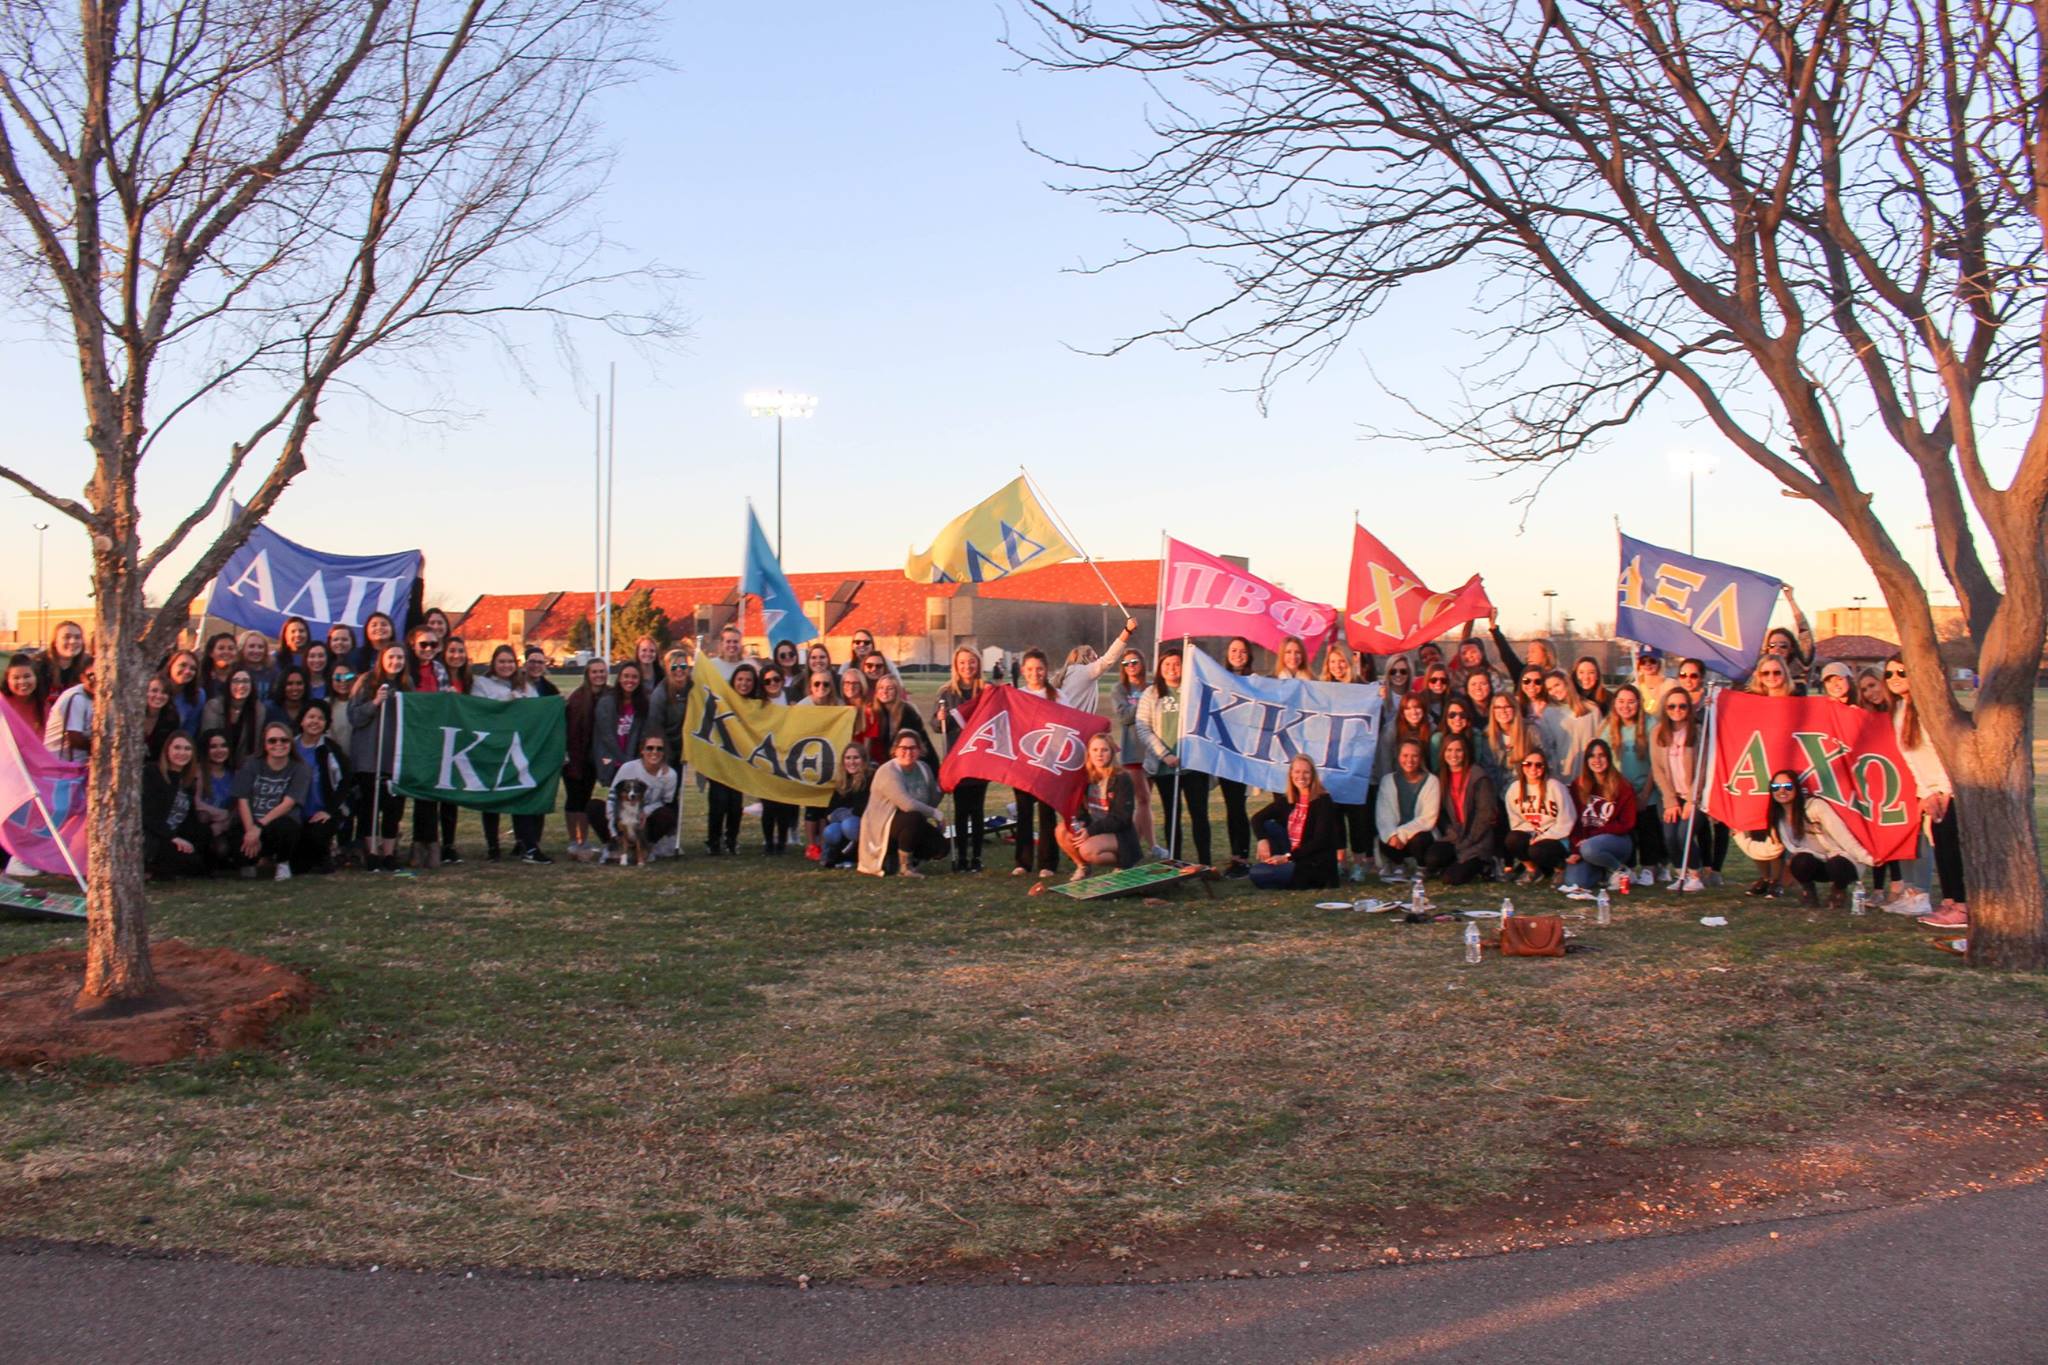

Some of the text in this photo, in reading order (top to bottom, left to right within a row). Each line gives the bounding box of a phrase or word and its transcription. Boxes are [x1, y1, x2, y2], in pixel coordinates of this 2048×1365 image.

[227, 548, 407, 628] ΑΔΠ
[1167, 561, 1333, 639] ΠΒΦ
[1617, 554, 1744, 652] ΑΞΔ
[433, 725, 538, 792] ΚΔ
[690, 684, 836, 786] ΚΑΘ
[957, 709, 1088, 776] ΑΦ
[1184, 680, 1374, 773] ΚΚΓ
[1514, 795, 1559, 818] XAS
[1723, 730, 1909, 826] ΑΧΩ
